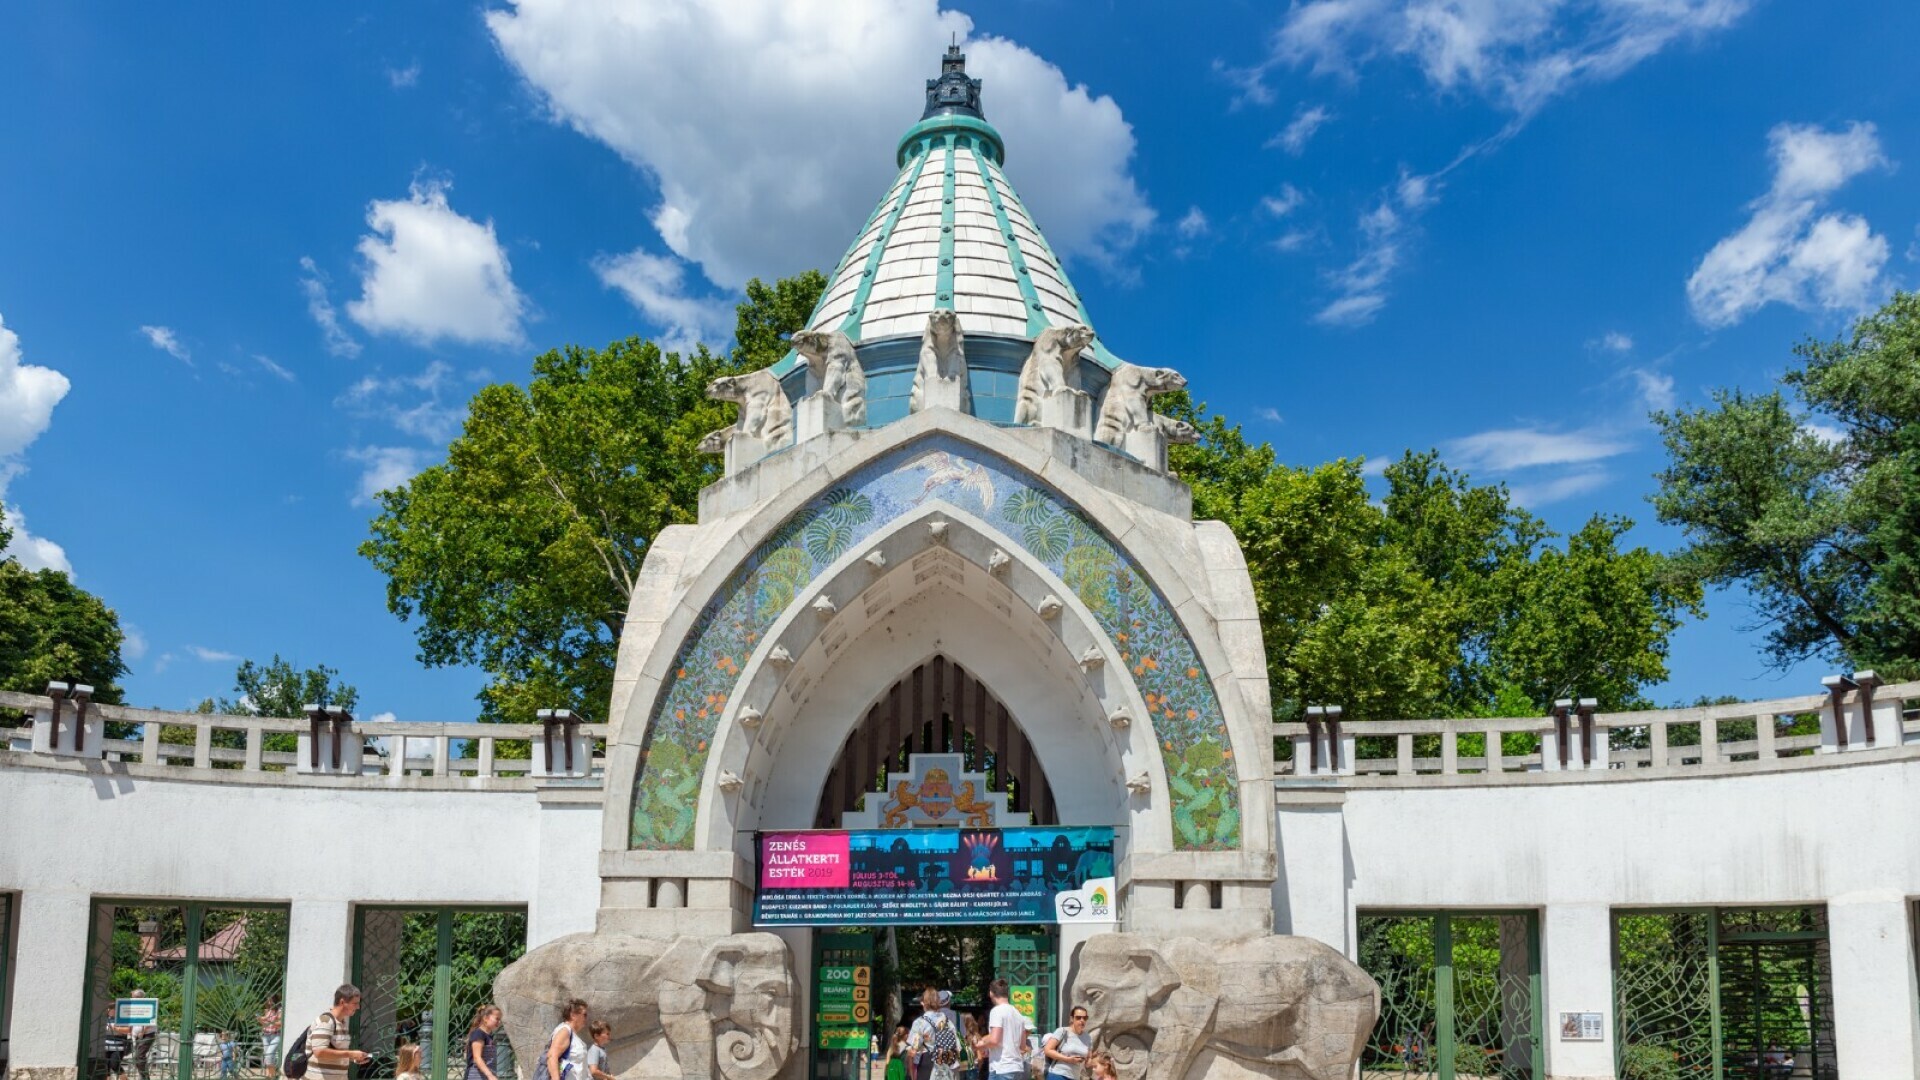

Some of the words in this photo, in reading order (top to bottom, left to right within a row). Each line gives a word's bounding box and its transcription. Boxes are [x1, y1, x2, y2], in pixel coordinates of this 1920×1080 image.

[769, 839, 806, 851] ZENÉS
[768, 853, 840, 865] ÁLLATKERTI
[768, 866, 805, 878] ESTÉK
[808, 867, 833, 877] 2019
[852, 871, 876, 879] JÚLIUS
[826, 969, 851, 980] ZOO
